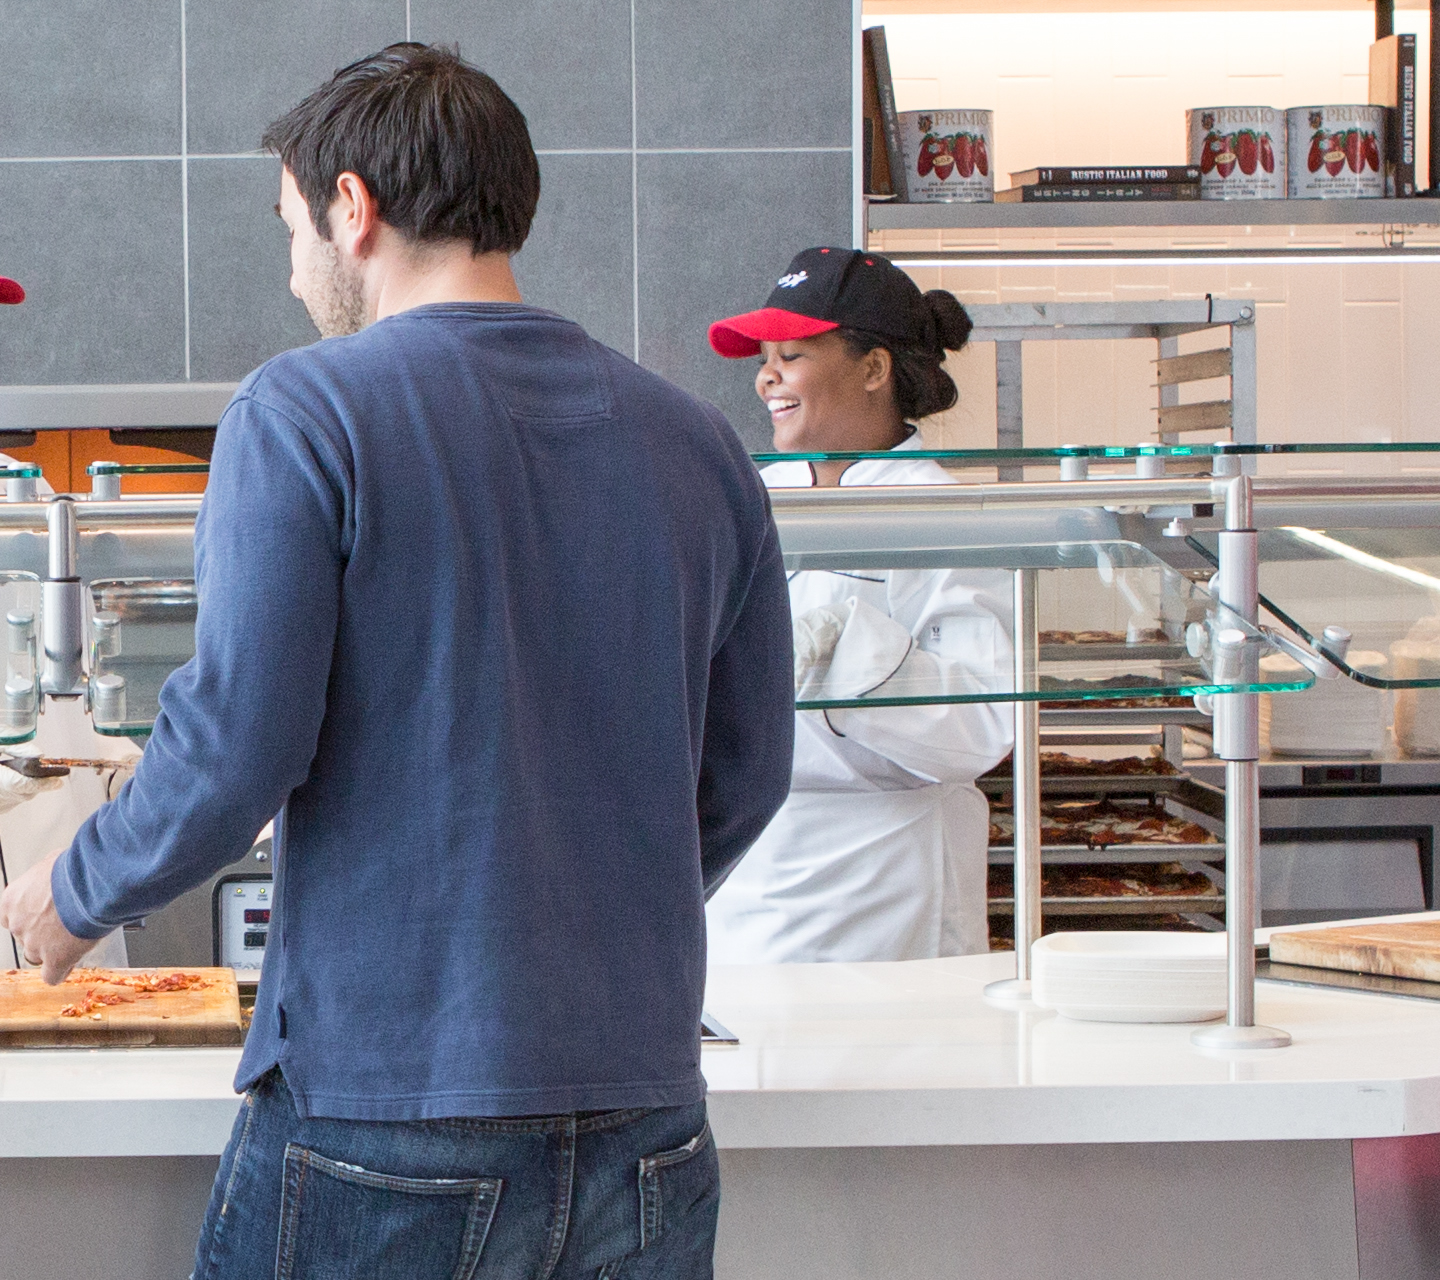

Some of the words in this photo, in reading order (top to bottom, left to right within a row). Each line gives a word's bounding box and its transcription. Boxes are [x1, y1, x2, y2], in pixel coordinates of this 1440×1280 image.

[1404, 66, 1414, 99] RUSTIC
[1404, 100, 1414, 139] ITALIAN
[1404, 140, 1414, 164] FOOD
[1071, 170, 1104, 180] RUSTIC
[1106, 169, 1142, 179] ITALIAN
[1144, 169, 1168, 179] FOOD
